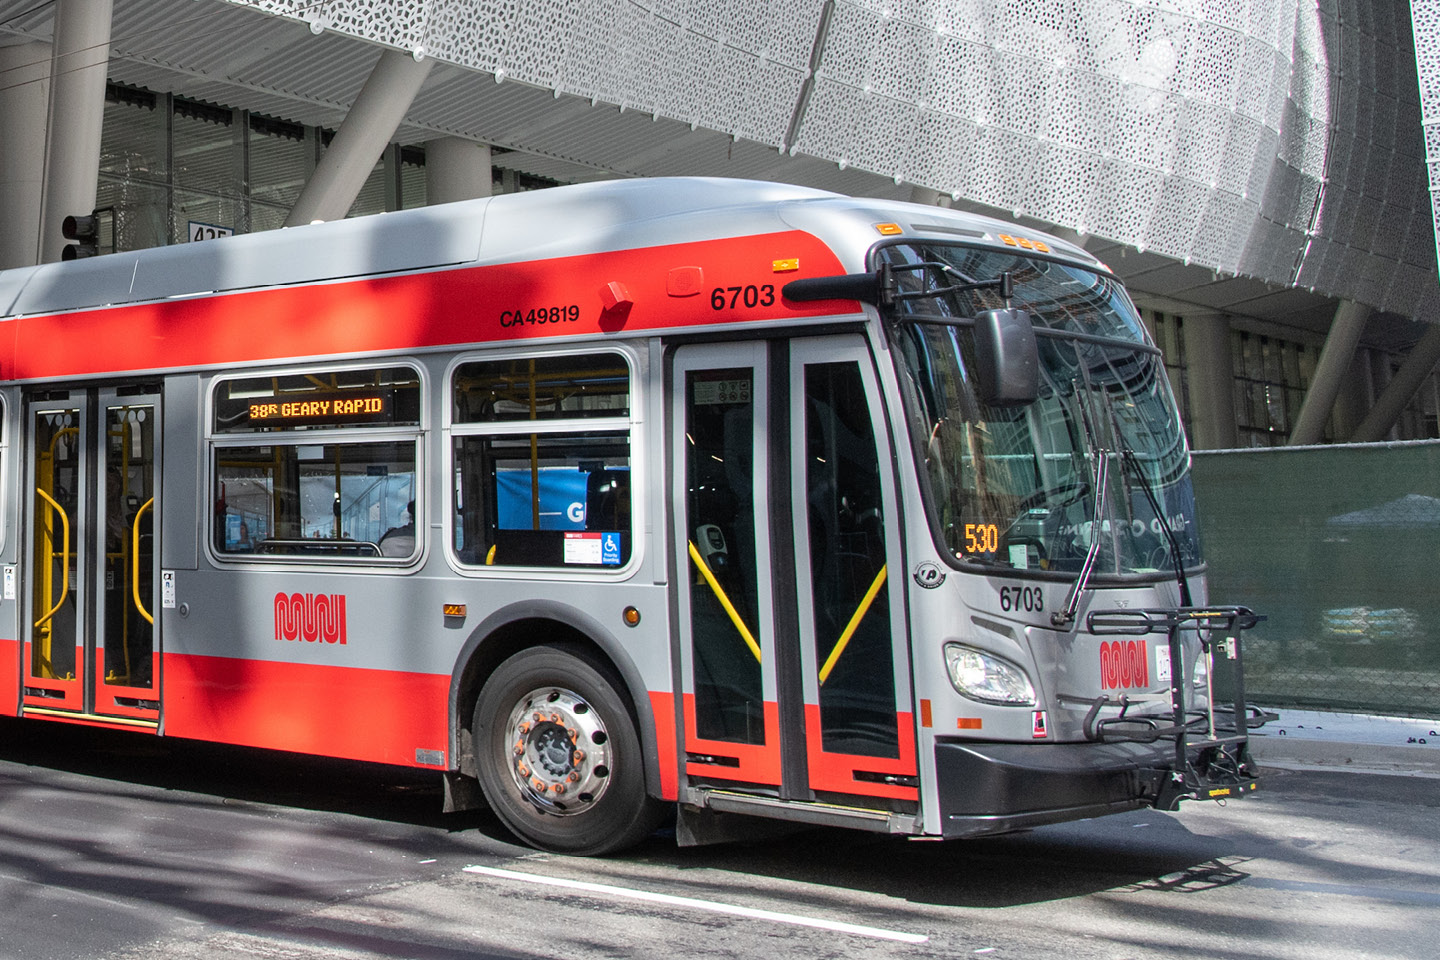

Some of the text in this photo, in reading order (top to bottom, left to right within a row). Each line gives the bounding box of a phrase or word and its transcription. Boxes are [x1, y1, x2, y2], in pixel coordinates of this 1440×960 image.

[711, 284, 775, 310] 6703
[500, 305, 580, 327] CA49819
[250, 398, 382, 418] 38R GEARY RAPID
[567, 502, 587, 522] G
[965, 524, 998, 552] 530
[1000, 586, 1043, 612] 6703
